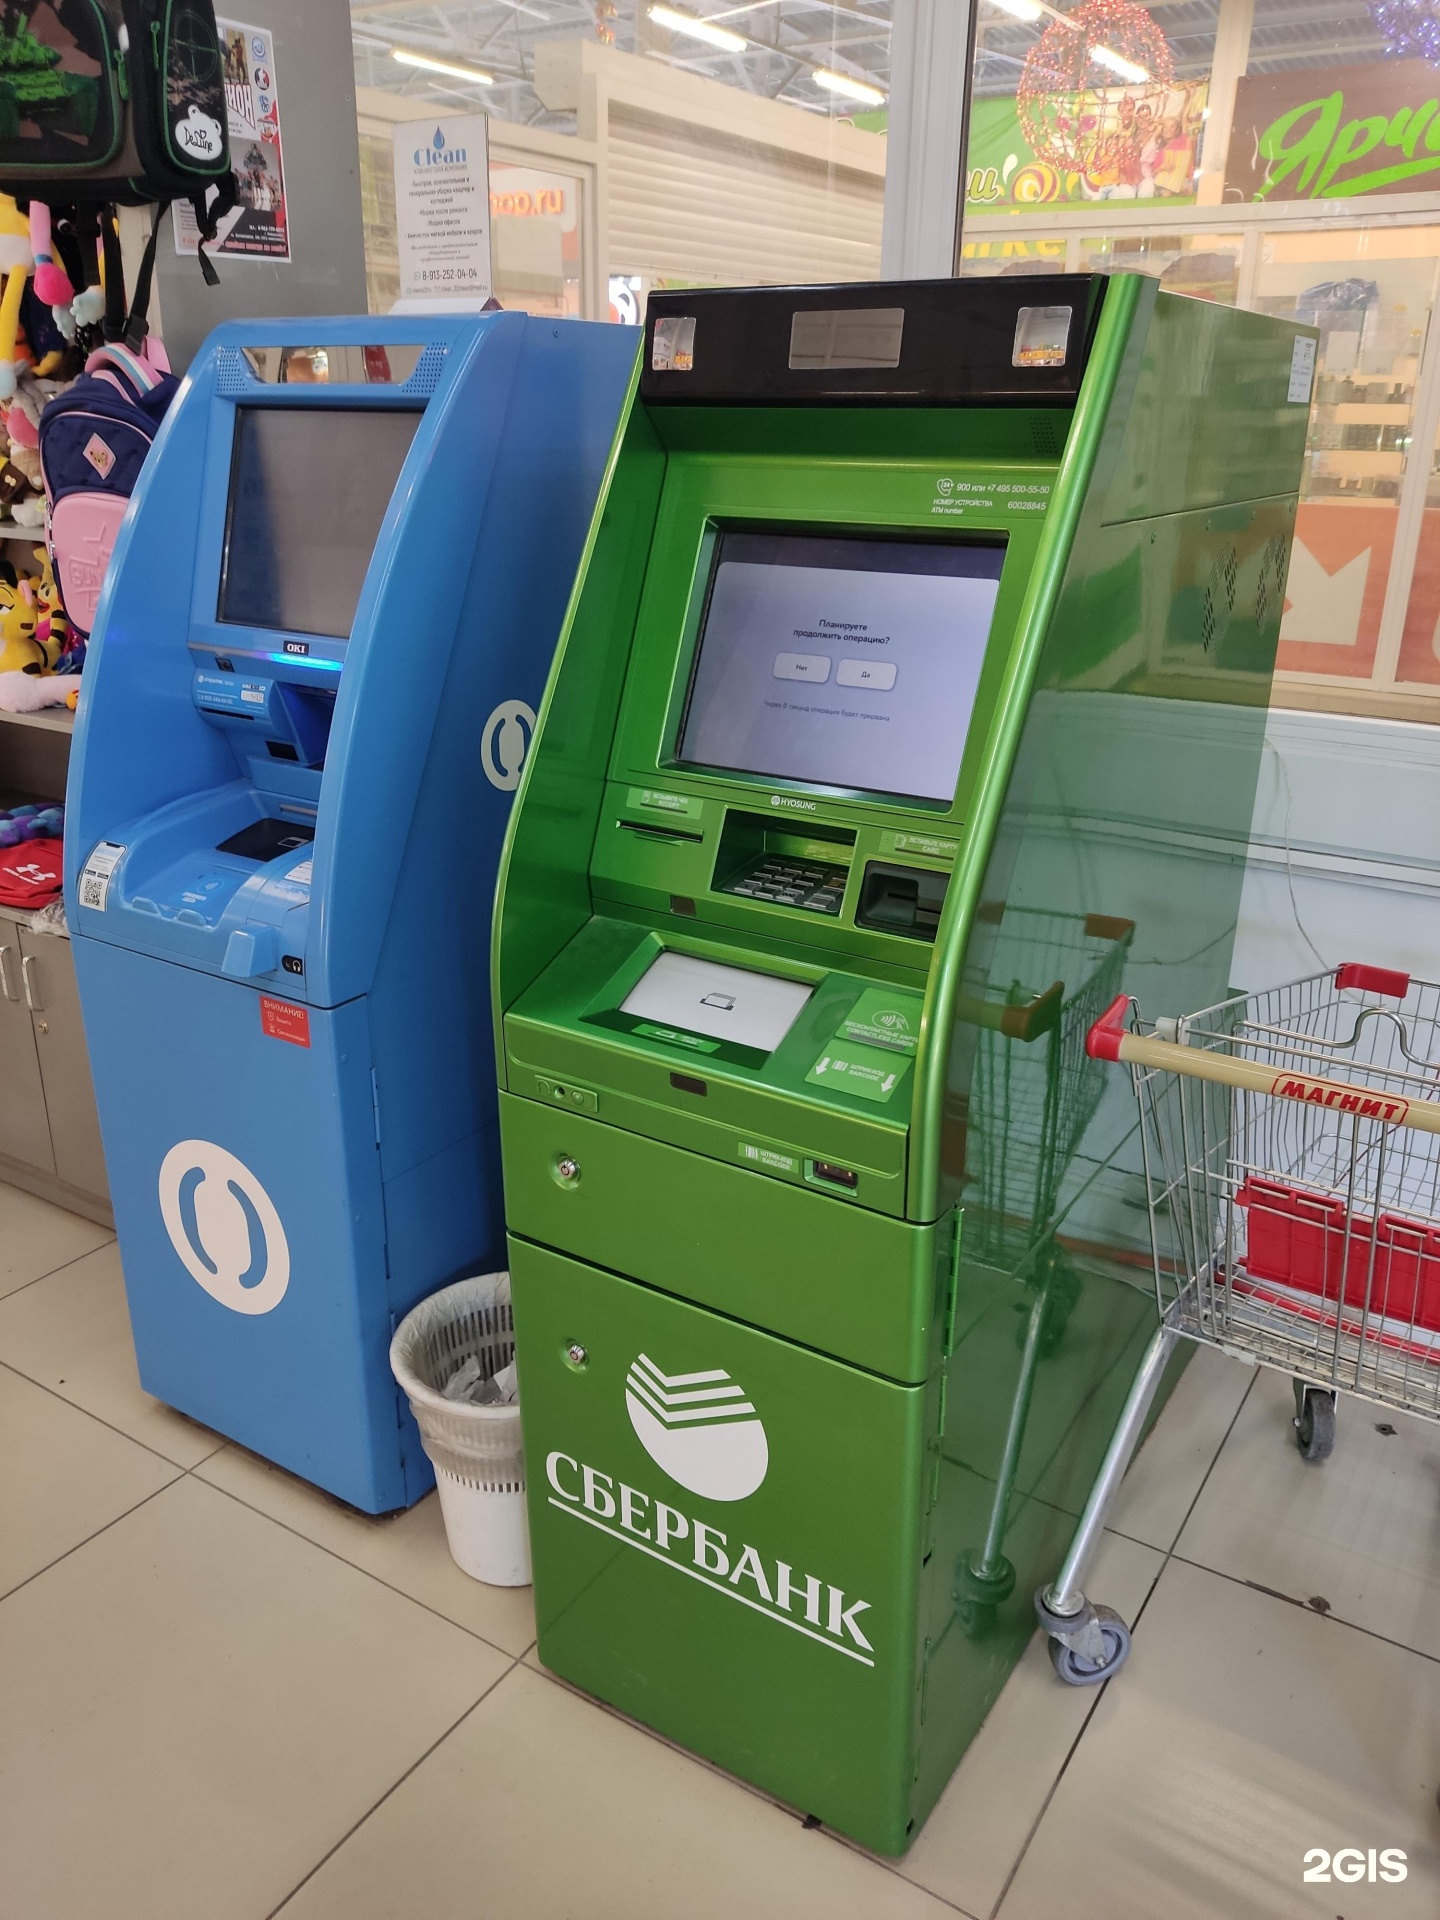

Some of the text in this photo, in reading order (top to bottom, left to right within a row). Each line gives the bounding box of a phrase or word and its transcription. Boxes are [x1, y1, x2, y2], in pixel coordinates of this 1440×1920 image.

[413, 148, 467, 167] Clean
[449, 207, 468, 215] ремонта
[422, 268, 478, 281] 8-913-252-04-04
[957, 483, 971, 491] 900
[987, 484, 996, 492] +7
[996, 484, 1010, 493] 495
[1012, 485, 1050, 494] 500-55-50
[955, 499, 992, 507] УСТРОЙСТВА
[1008, 501, 1046, 510] 60028845
[818, 619, 868, 631] Планируете
[793, 629, 890, 645] продолжить операцию?
[286, 643, 306, 653] OKI
[764, 701, 782, 709] Через
[789, 704, 809, 712] секунд
[810, 707, 840, 716] операция
[841, 709, 859, 719] будет
[860, 713, 890, 722] прервана
[780, 798, 816, 810] HYOSUNG
[909, 837, 958, 850] ВСТАВЬТЕ КАРТУ
[922, 846, 939, 854] CARD
[263, 1000, 304, 1019] ВНИМАНИЕ!
[844, 1020, 900, 1039] БЕСКОНТАКТНЫЕ
[846, 1027, 914, 1048] CONTACTLESS CARDS
[848, 1069, 880, 1082] BARCODE
[850, 1064, 885, 1077] ШТРИХ-КОД
[1280, 1081, 1400, 1120] МАГНИТ
[546, 1451, 875, 1652] СБЕРБАНК
